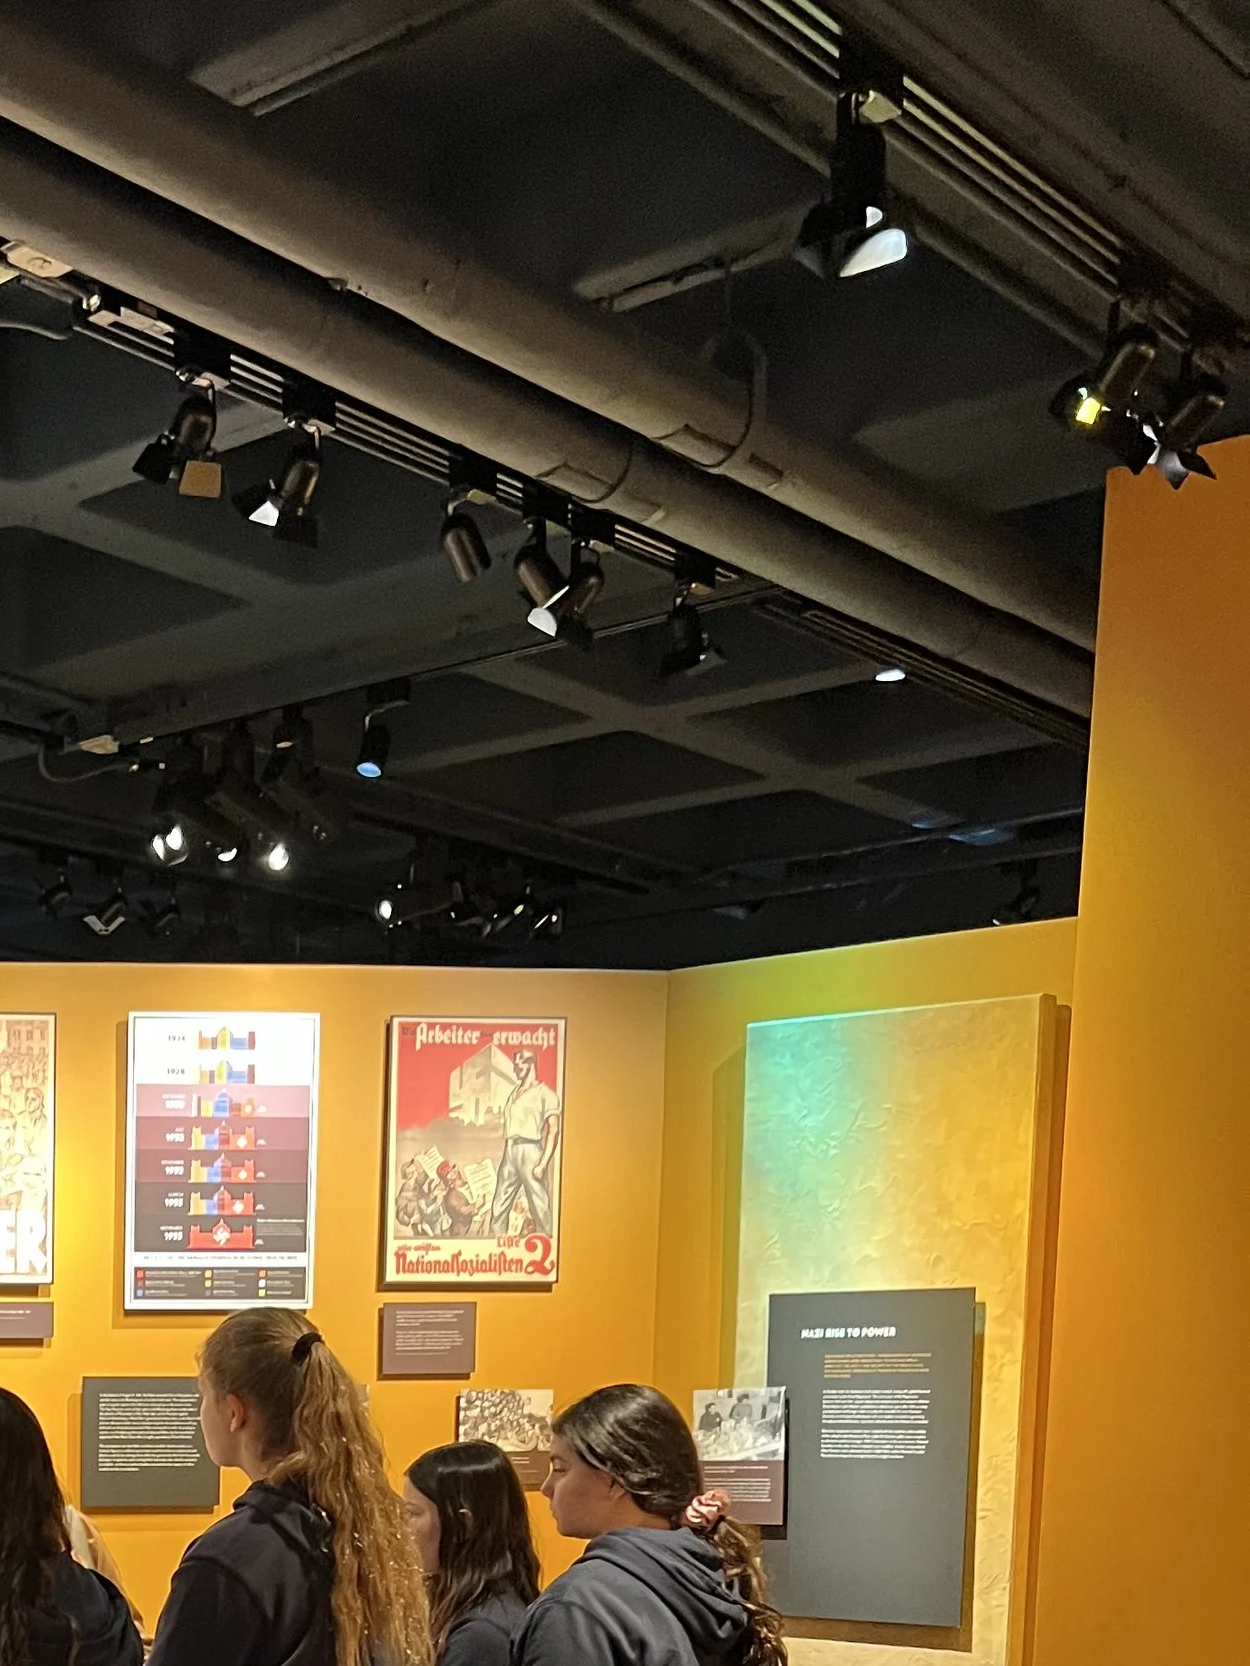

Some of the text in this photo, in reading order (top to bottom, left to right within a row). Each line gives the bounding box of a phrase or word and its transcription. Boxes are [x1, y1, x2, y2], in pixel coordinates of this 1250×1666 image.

[415, 1022, 556, 1052] Arbeiter erwacht
[524, 1232, 555, 1276] 2
[847, 1327, 861, 1338] TO
[861, 1326, 897, 1338] POWER
